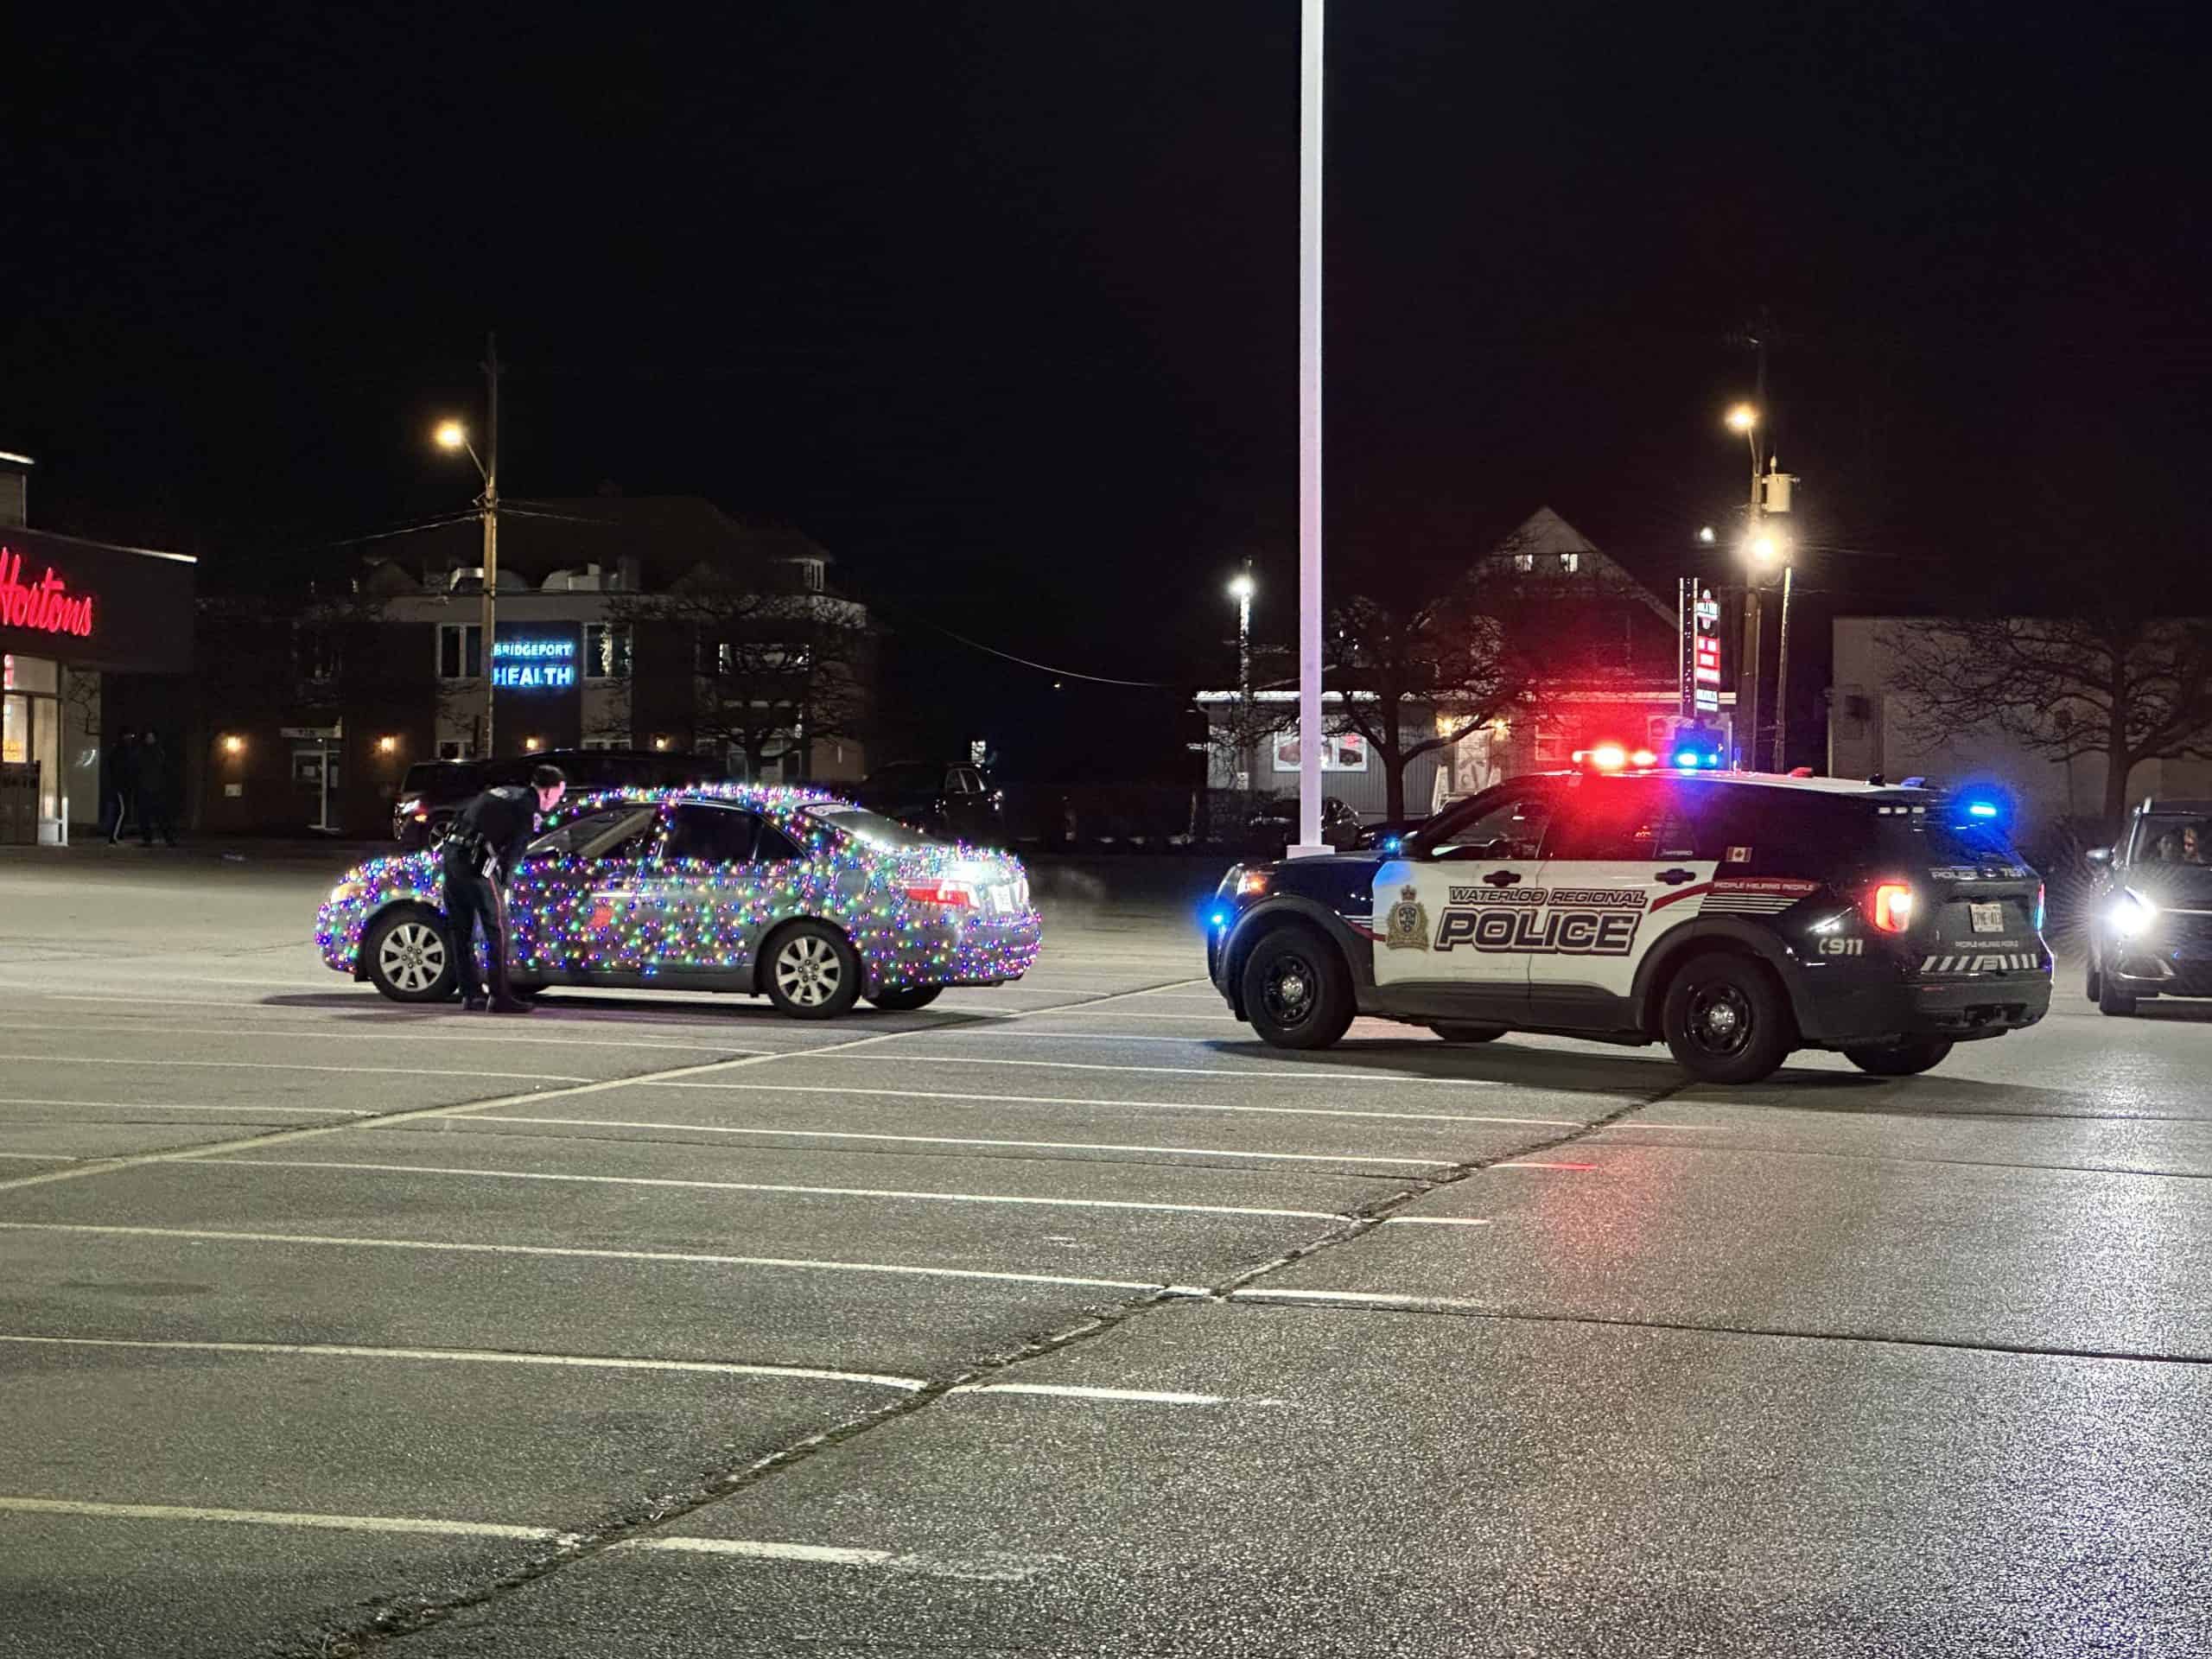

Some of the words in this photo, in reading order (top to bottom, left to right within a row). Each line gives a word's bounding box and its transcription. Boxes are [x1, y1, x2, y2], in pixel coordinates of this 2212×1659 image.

[0, 546, 92, 637] Hortons
[493, 643, 573, 657] BRIDGEPORT
[493, 666, 573, 686] HEALTH
[1449, 886, 1547, 905] WATERLOO
[1548, 887, 1648, 908] REGIONAL
[1435, 908, 1643, 956] POLICE
